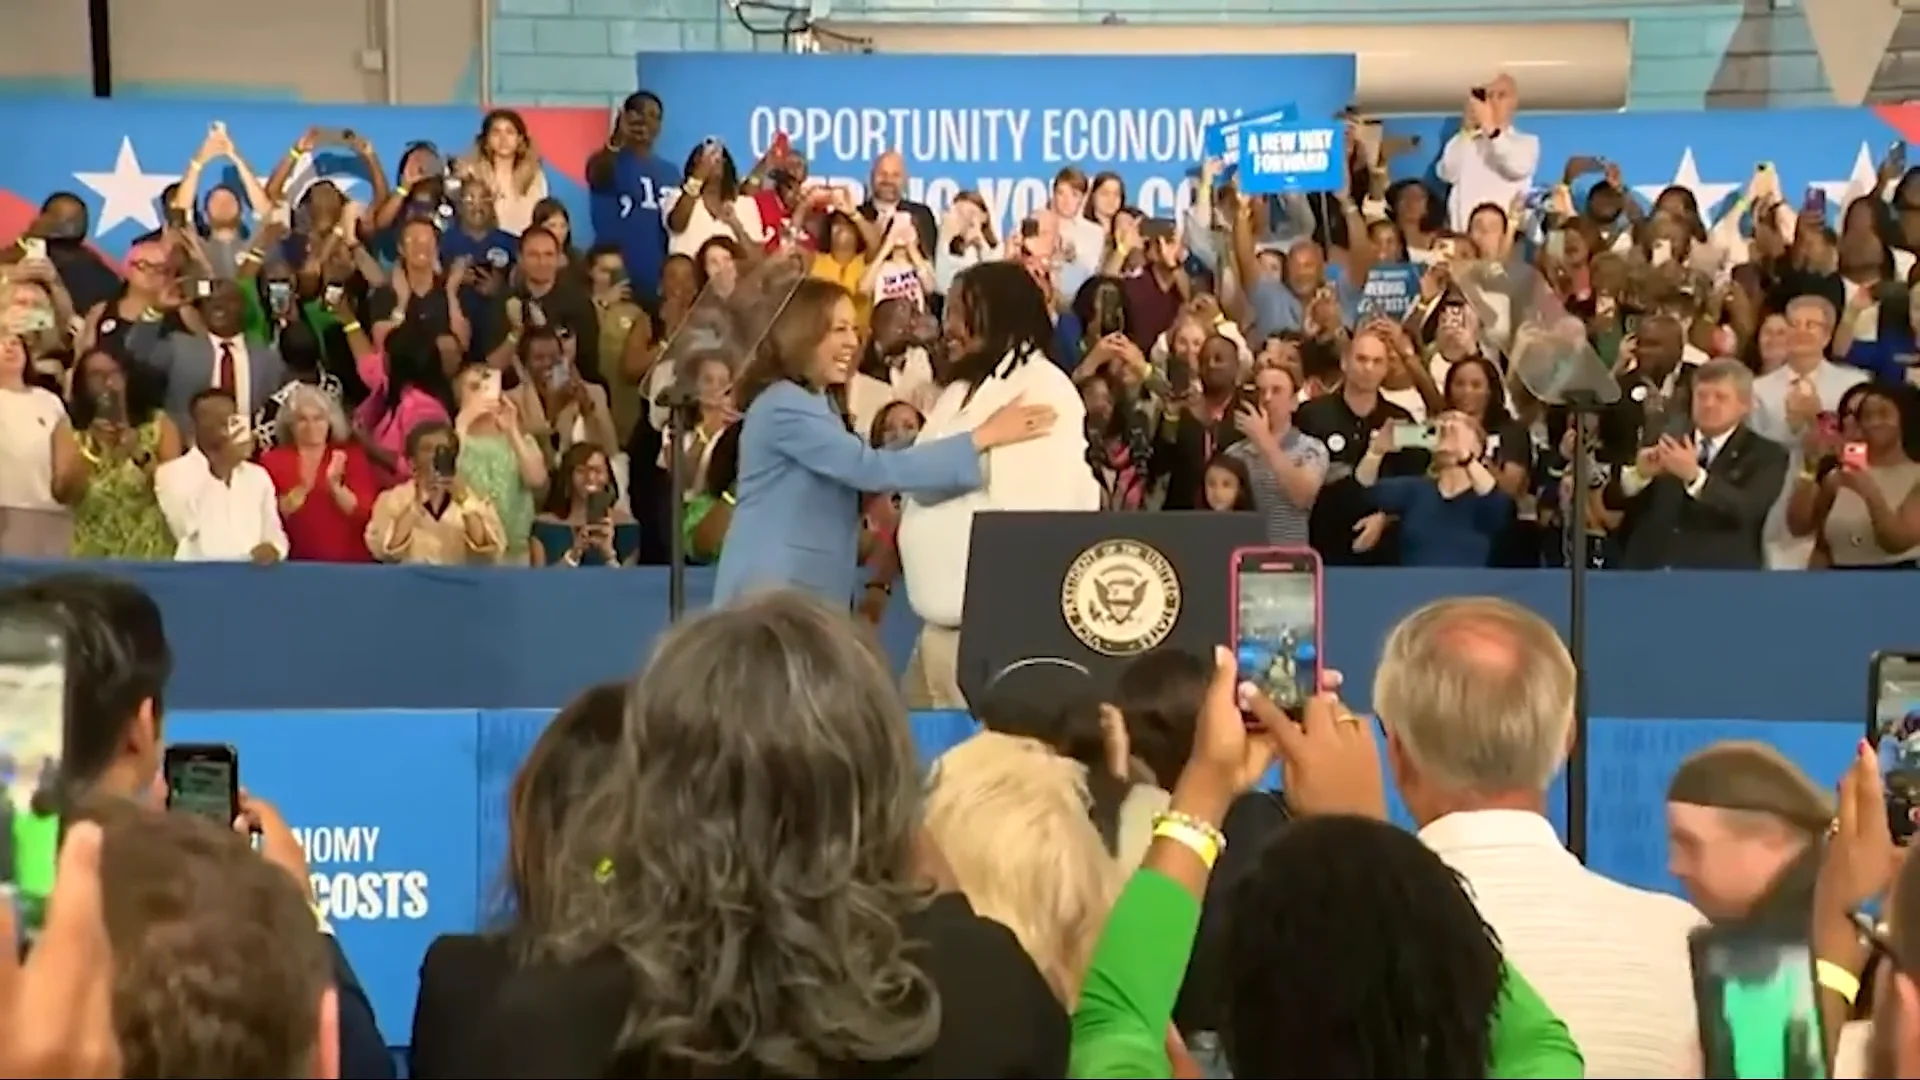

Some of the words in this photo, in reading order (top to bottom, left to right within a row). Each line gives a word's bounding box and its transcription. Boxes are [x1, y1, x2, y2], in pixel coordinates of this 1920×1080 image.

[750, 106, 1030, 162] OPPORTUNITY
[1043, 107, 1243, 162] ECONOM
[1248, 131, 1259, 153] A
[1261, 130, 1297, 152] NEW
[1300, 128, 1334, 150] WAY
[1254, 150, 1330, 174] FORWARD
[309, 870, 429, 920] COSTS
